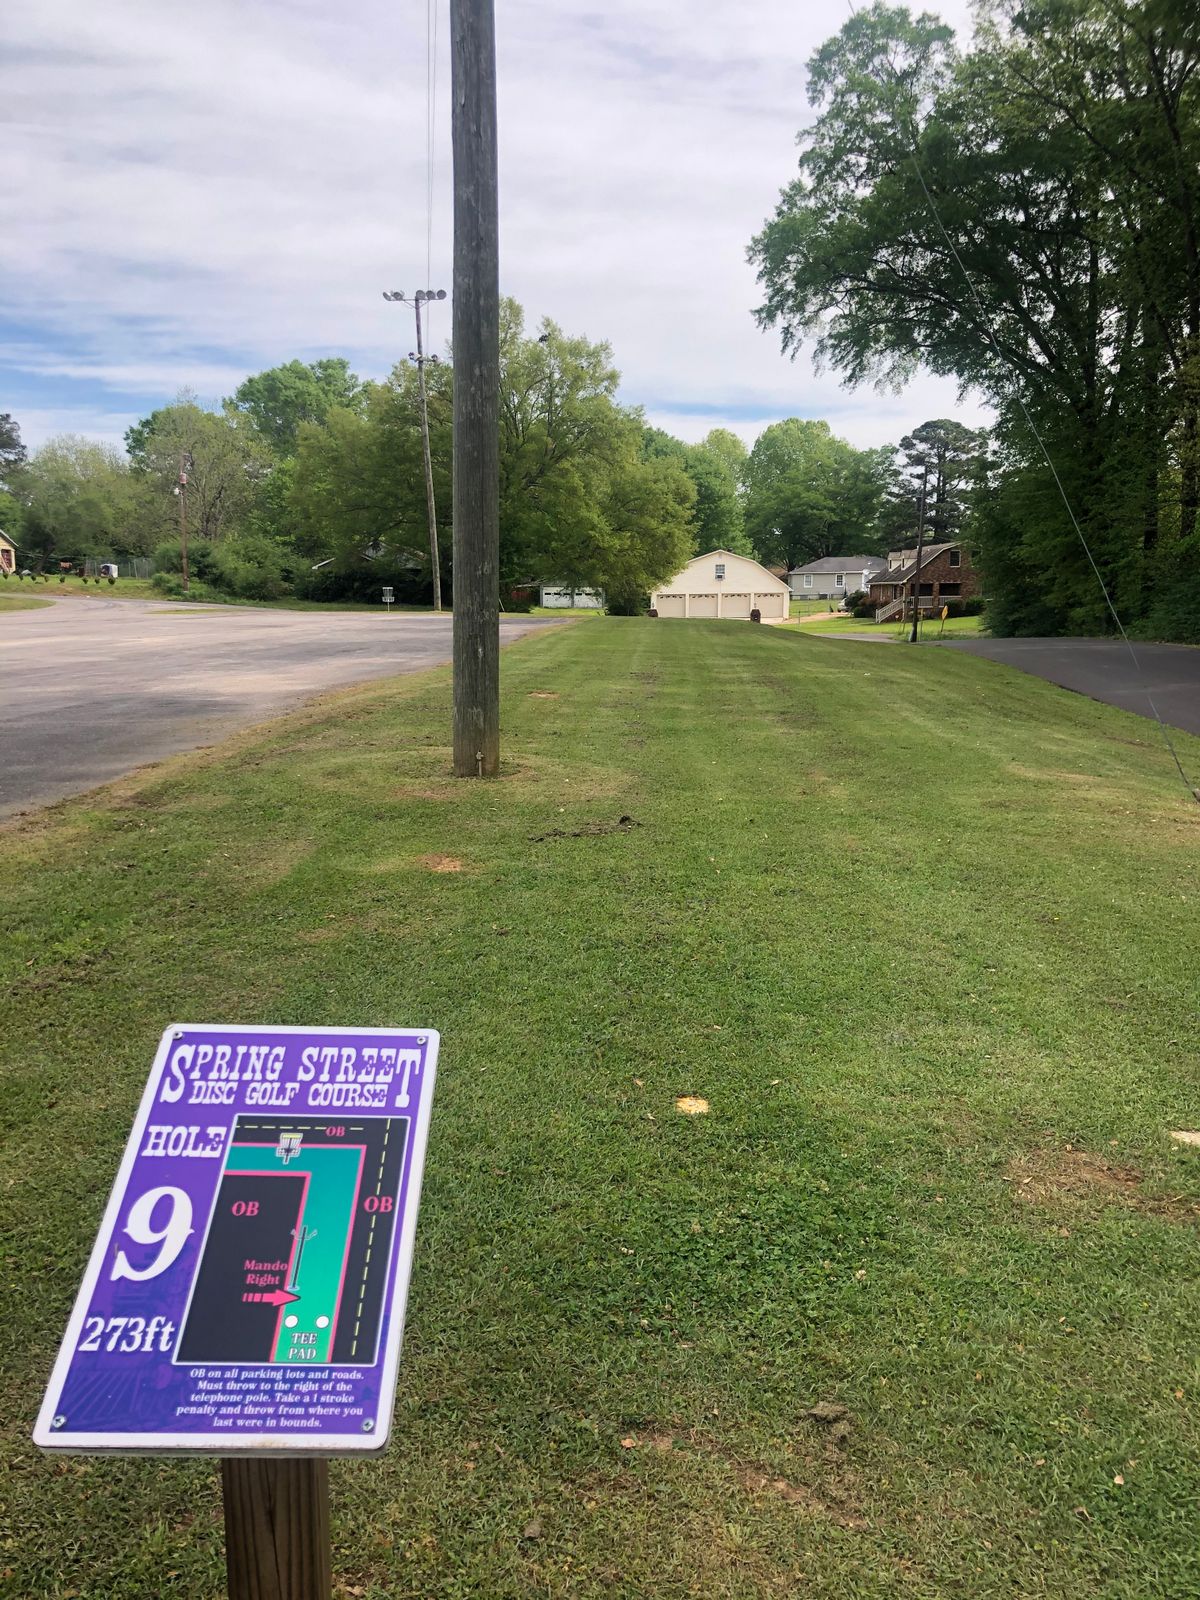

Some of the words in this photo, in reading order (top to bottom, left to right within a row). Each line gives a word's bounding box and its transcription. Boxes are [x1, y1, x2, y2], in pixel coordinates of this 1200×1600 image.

[160, 1044, 285, 1103] SPRING
[297, 1047, 422, 1107] STREET
[189, 1081, 238, 1104] DISC
[246, 1082, 300, 1105] GOLF
[308, 1083, 389, 1107] COURSE
[325, 1126, 345, 1137] OB
[141, 1126, 227, 1158] HOLE
[231, 1201, 259, 1216] OB
[364, 1196, 393, 1212] OB
[109, 1186, 194, 1281] 9
[244, 1260, 288, 1271] Mando
[246, 1273, 280, 1286] Right
[78, 1315, 175, 1352] 273ft
[292, 1333, 318, 1344] TEE
[288, 1348, 317, 1360] PAD
[190, 1369, 205, 1378] OB
[208, 1370, 222, 1378] on
[224, 1369, 238, 1378] all
[241, 1369, 283, 1380] parking
[286, 1370, 305, 1379] lots
[307, 1370, 328, 1379] and
[332, 1370, 364, 1379] roads.
[198, 1381, 223, 1389] Must
[226, 1381, 258, 1390] throw
[260, 1382, 271, 1390] to
[274, 1382, 291, 1390] the
[294, 1382, 319, 1392] right
[322, 1382, 334, 1391] of
[336, 1382, 352, 1391] the
[190, 1393, 244, 1403] telephone
[245, 1394, 271, 1403] pole.
[275, 1393, 300, 1402] Take
[303, 1395, 310, 1403] a
[320, 1394, 354, 1403] stroke
[176, 1405, 217, 1416] penalty
[220, 1405, 241, 1414] and
[244, 1406, 275, 1414] throw
[279, 1406, 305, 1415] from
[308, 1406, 340, 1415] where
[343, 1408, 363, 1416] you
[213, 1417, 233, 1426] last
[237, 1419, 263, 1427] were
[266, 1418, 277, 1427] in
[280, 1418, 322, 1427] bounds.
